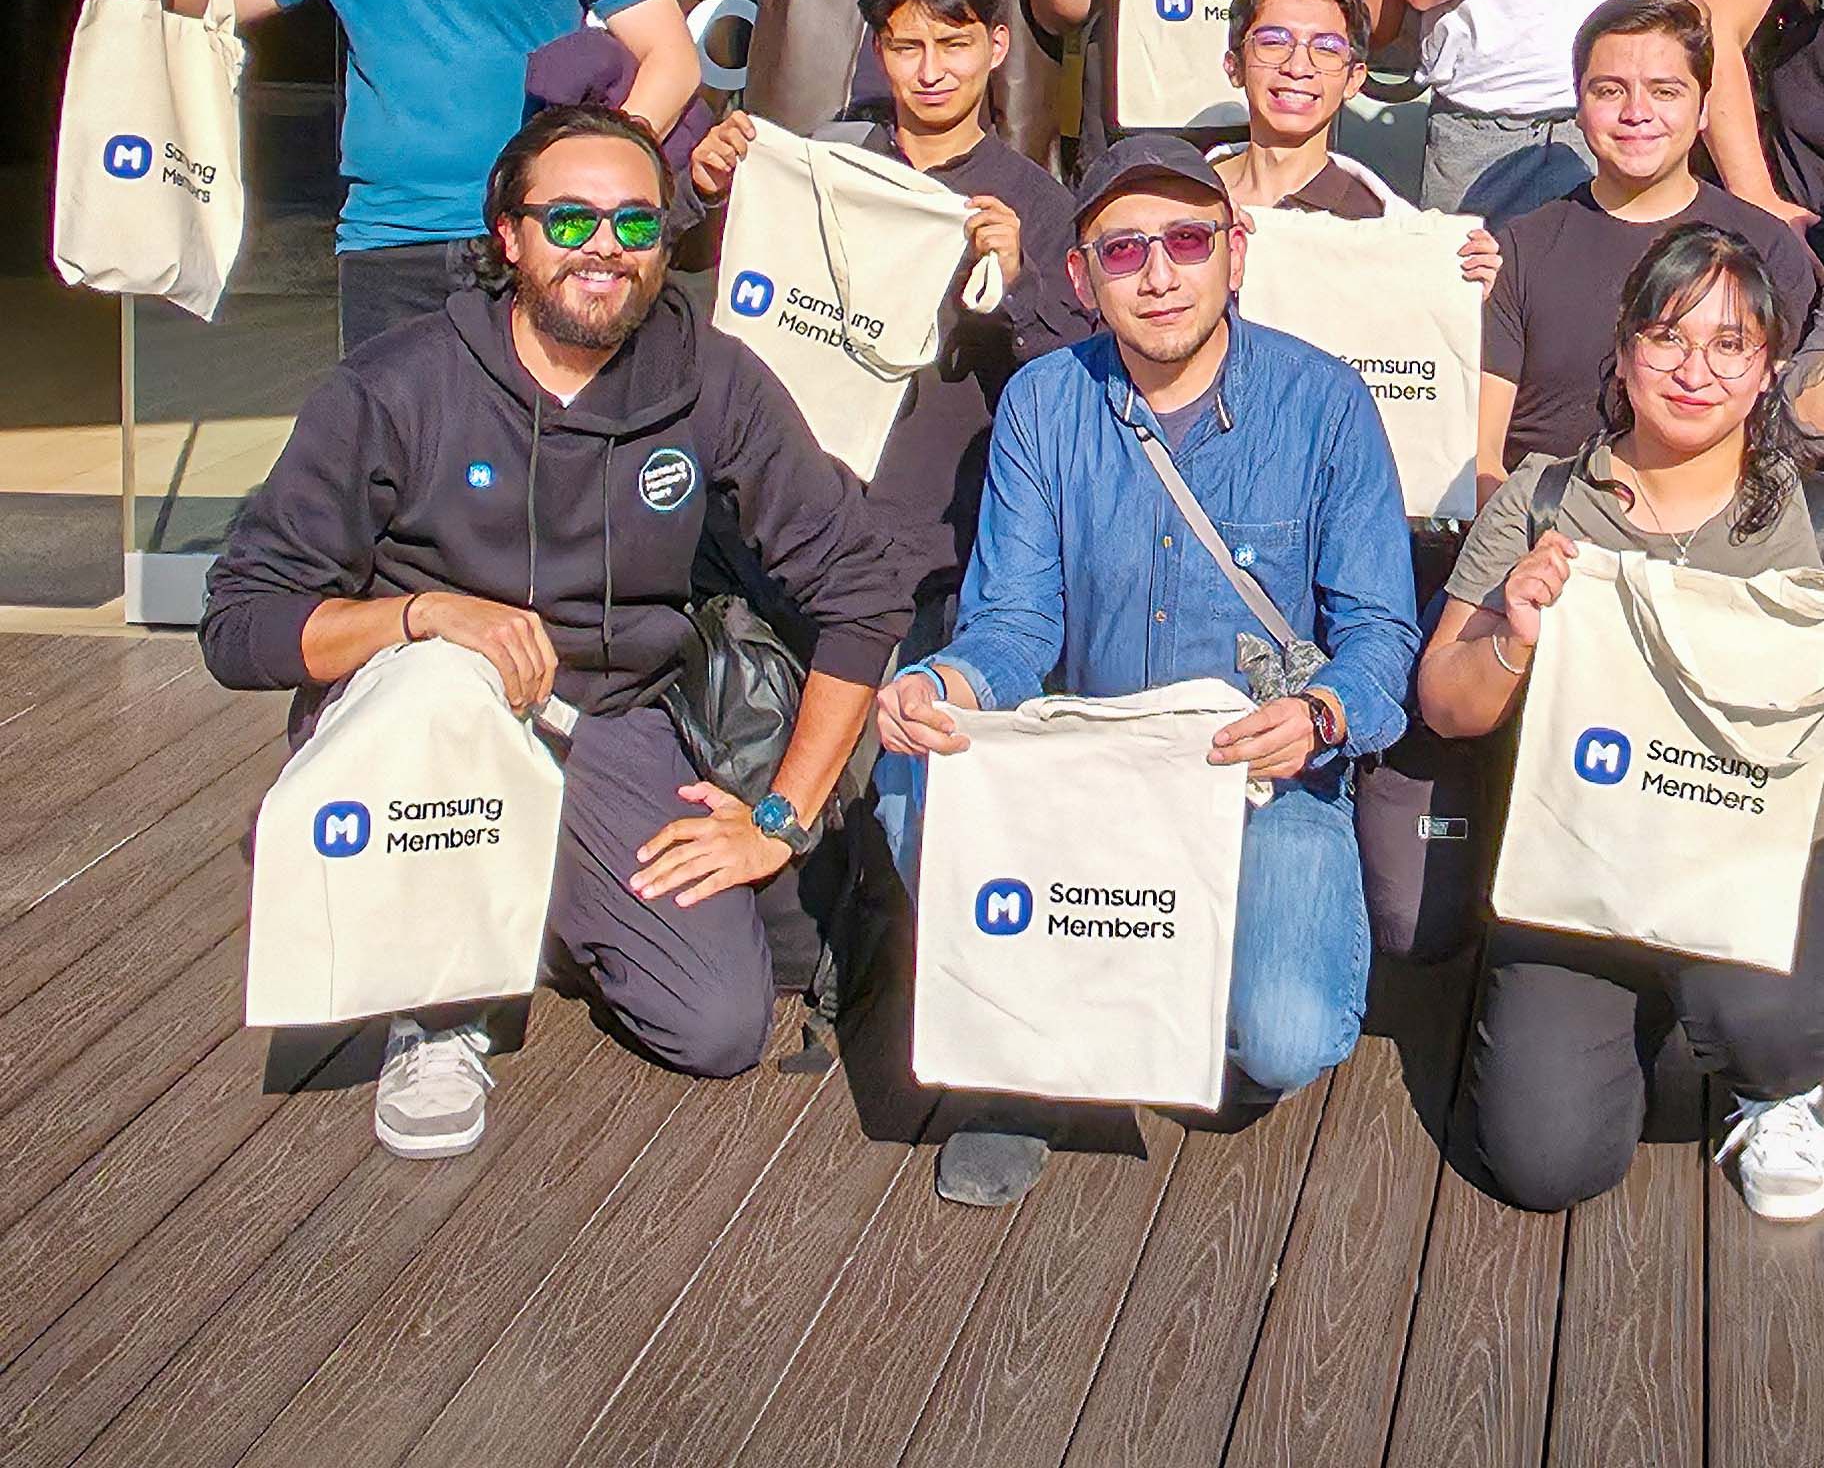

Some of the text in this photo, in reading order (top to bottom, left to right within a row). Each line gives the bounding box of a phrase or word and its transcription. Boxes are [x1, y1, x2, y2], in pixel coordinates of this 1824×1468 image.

[1367, 383, 1437, 401] mbers
[1646, 739, 1769, 789] Samsung
[1641, 770, 1765, 815] Members
[387, 796, 504, 821] Samsung
[386, 826, 500, 854] Members
[1048, 881, 1177, 914] Samsung
[1047, 913, 1176, 940] Members
